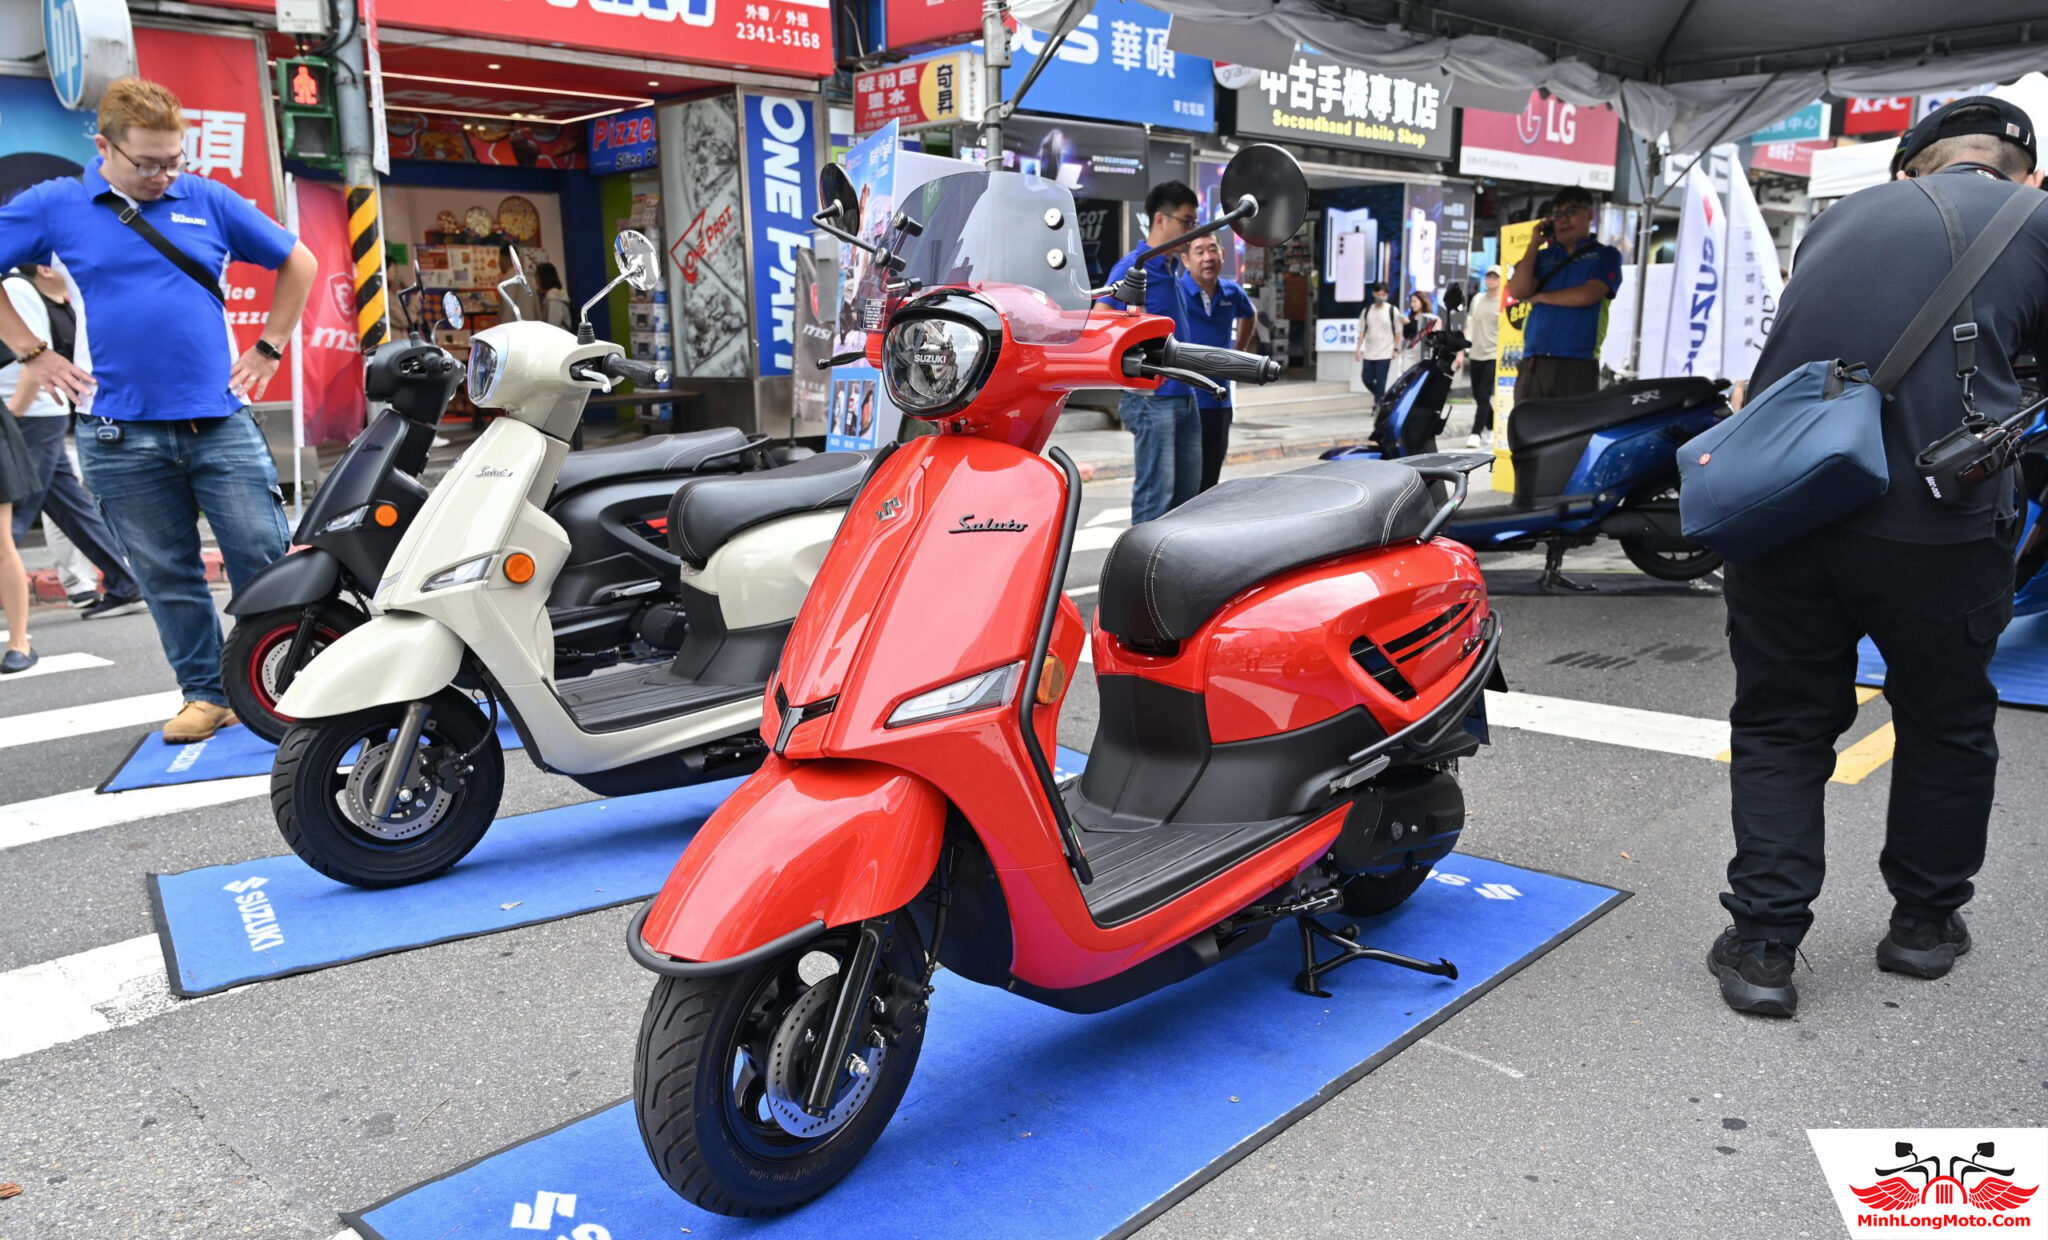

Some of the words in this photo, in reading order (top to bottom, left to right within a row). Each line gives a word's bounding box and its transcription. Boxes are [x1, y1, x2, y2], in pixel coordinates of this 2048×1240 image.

[50, 0, 78, 104] hp
[735, 21, 821, 49] 2341-5168
[1260, 58, 1440, 130] 中古手機專賣店
[1273, 109, 1352, 137] Secondhand
[1355, 121, 1395, 143] Mobile
[1397, 127, 1426, 149] Shop
[1546, 99, 1576, 144] LG
[760, 96, 805, 219] ONE
[310, 326, 362, 353] ms
[803, 323, 832, 340] msi
[913, 353, 947, 364] SUZUKI
[948, 514, 1028, 534] Saluto
[233, 889, 286, 952] SUZUKI
